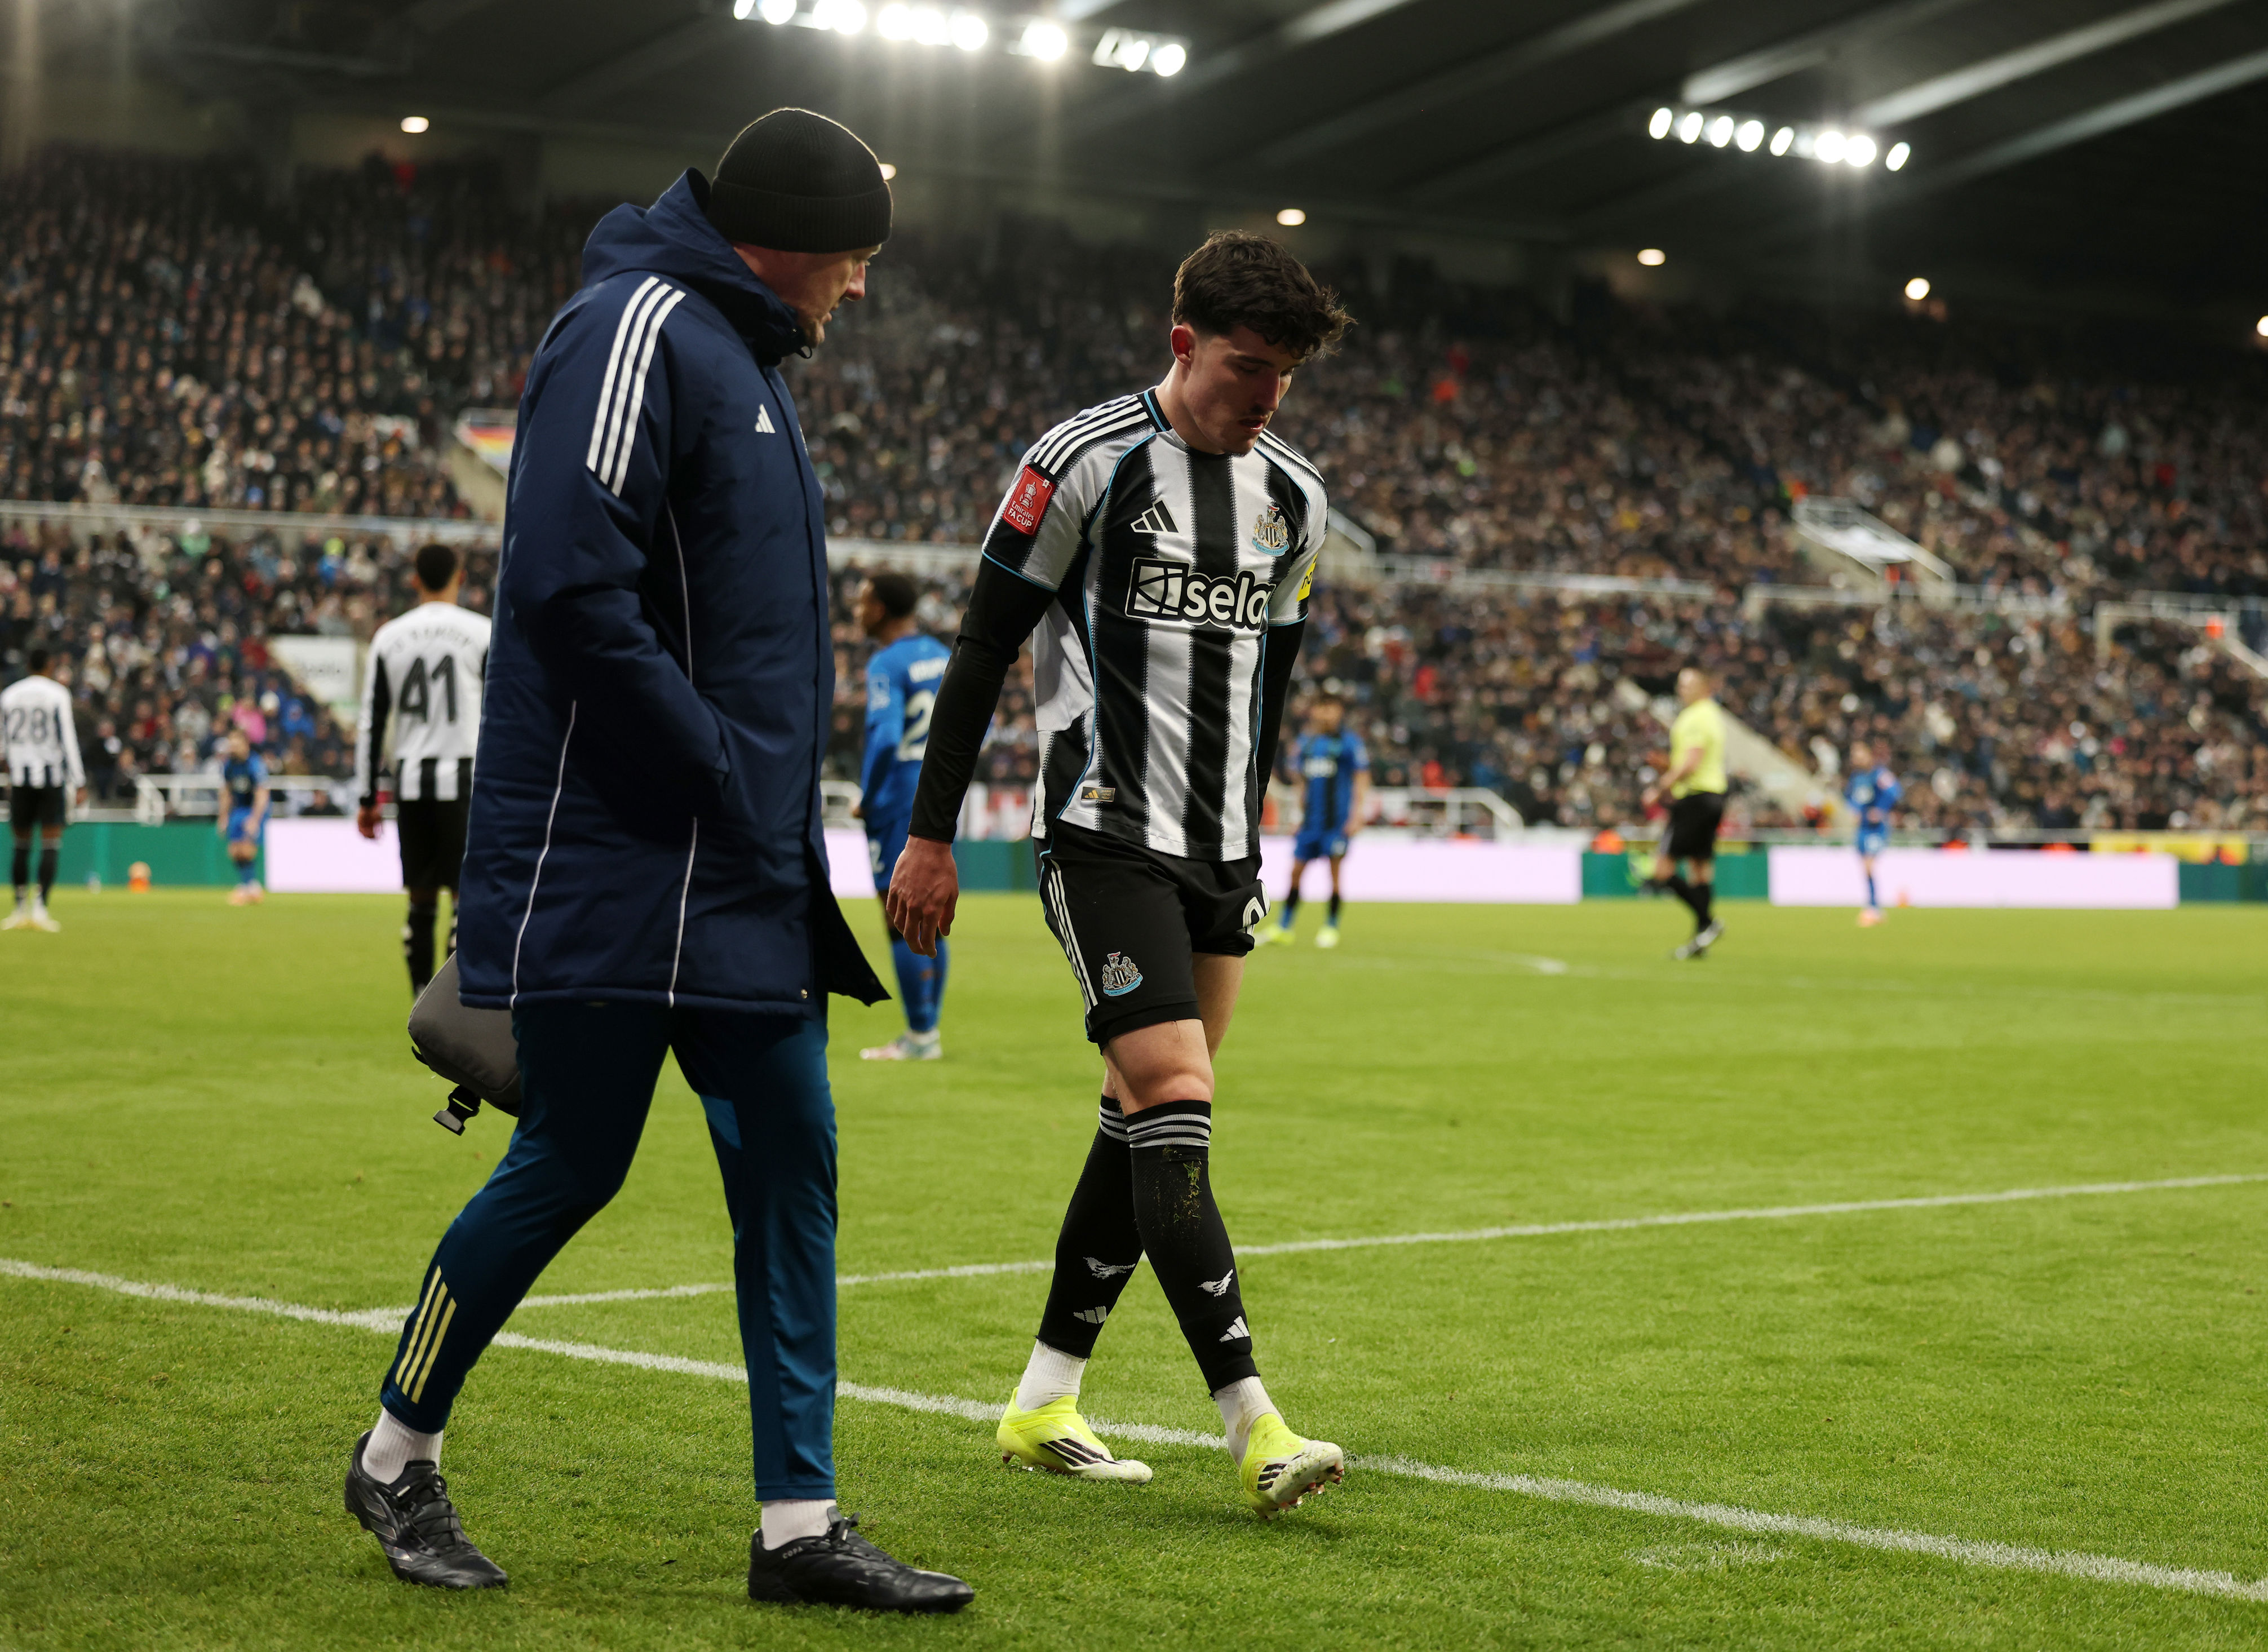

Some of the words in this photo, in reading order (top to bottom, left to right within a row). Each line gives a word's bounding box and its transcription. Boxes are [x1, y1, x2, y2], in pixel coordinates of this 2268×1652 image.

[1008, 508, 1016, 519] FA
[1016, 515, 1032, 528] CUP
[1011, 501, 1035, 521] Emirates
[1183, 577, 1272, 625] sela
[399, 654, 457, 723] 41
[10, 708, 47, 745] 28
[782, 1545, 803, 1560] COPA
